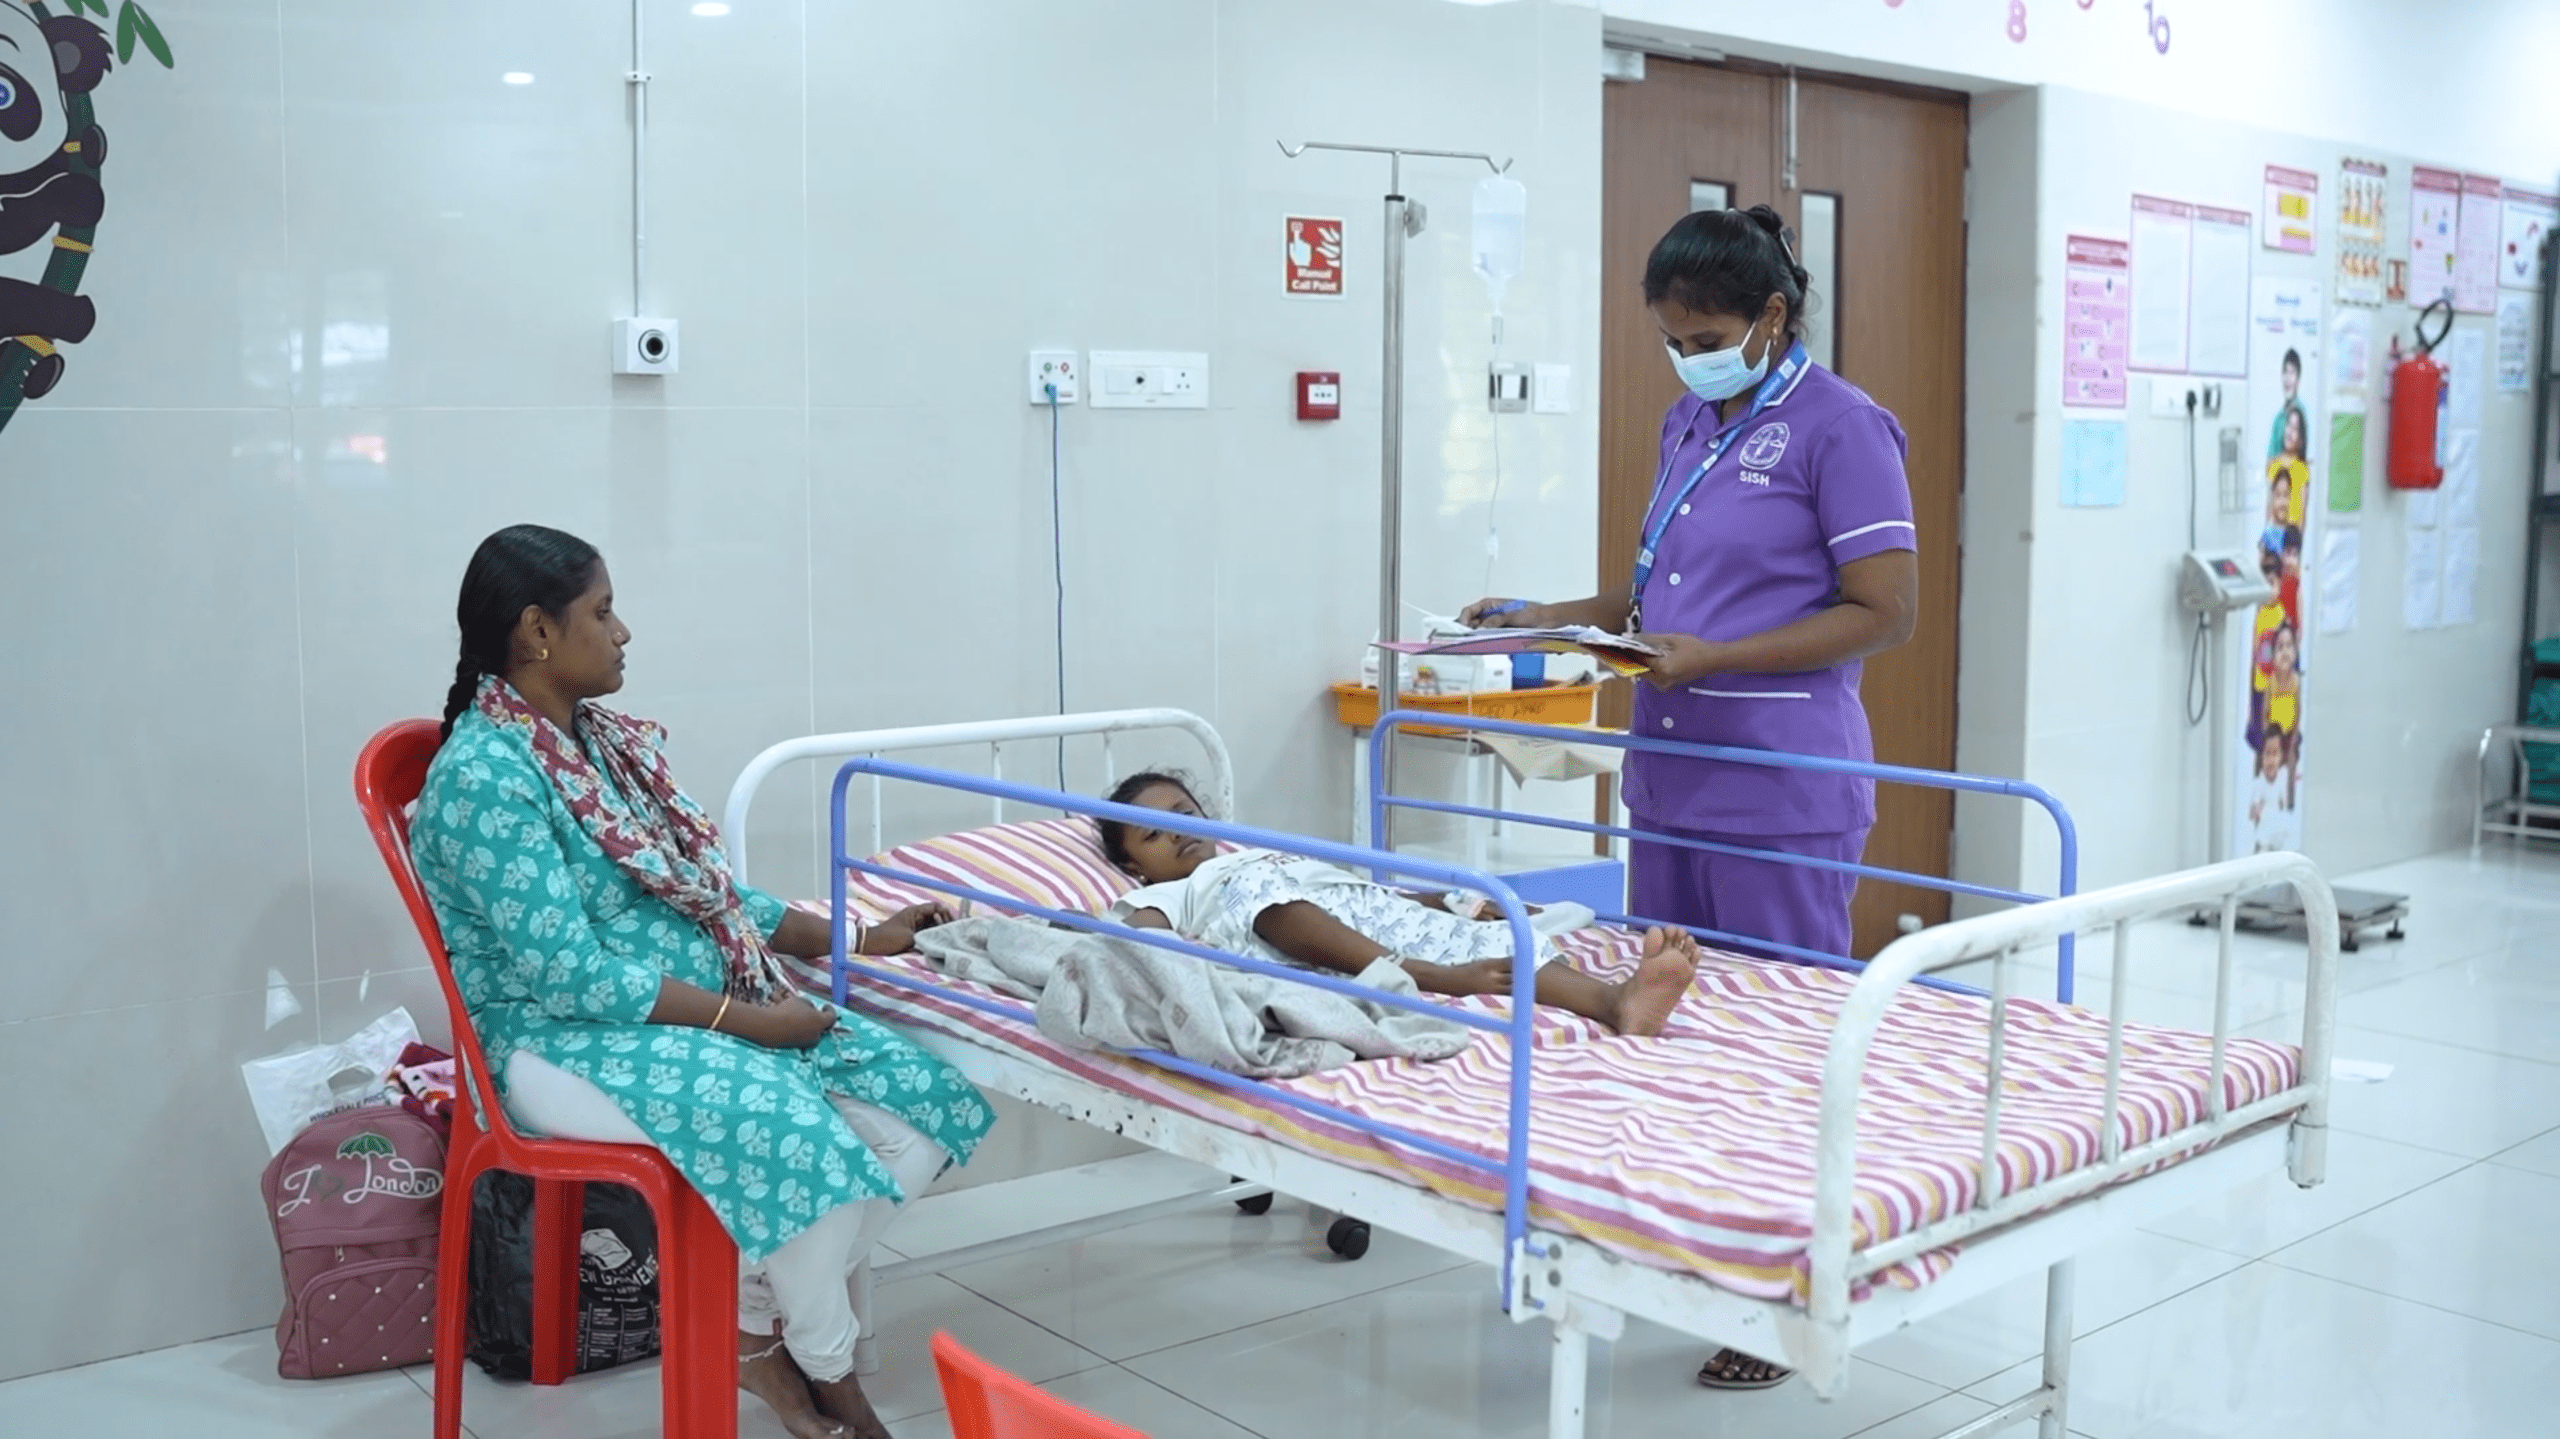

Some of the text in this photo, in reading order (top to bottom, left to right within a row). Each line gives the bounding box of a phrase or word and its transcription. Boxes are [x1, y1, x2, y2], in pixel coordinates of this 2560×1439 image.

[2144, 0, 2171, 55] 10
[1291, 279, 1338, 292] Call Point
[1739, 470, 1770, 486] SISH
[343, 1154, 443, 1204] London
